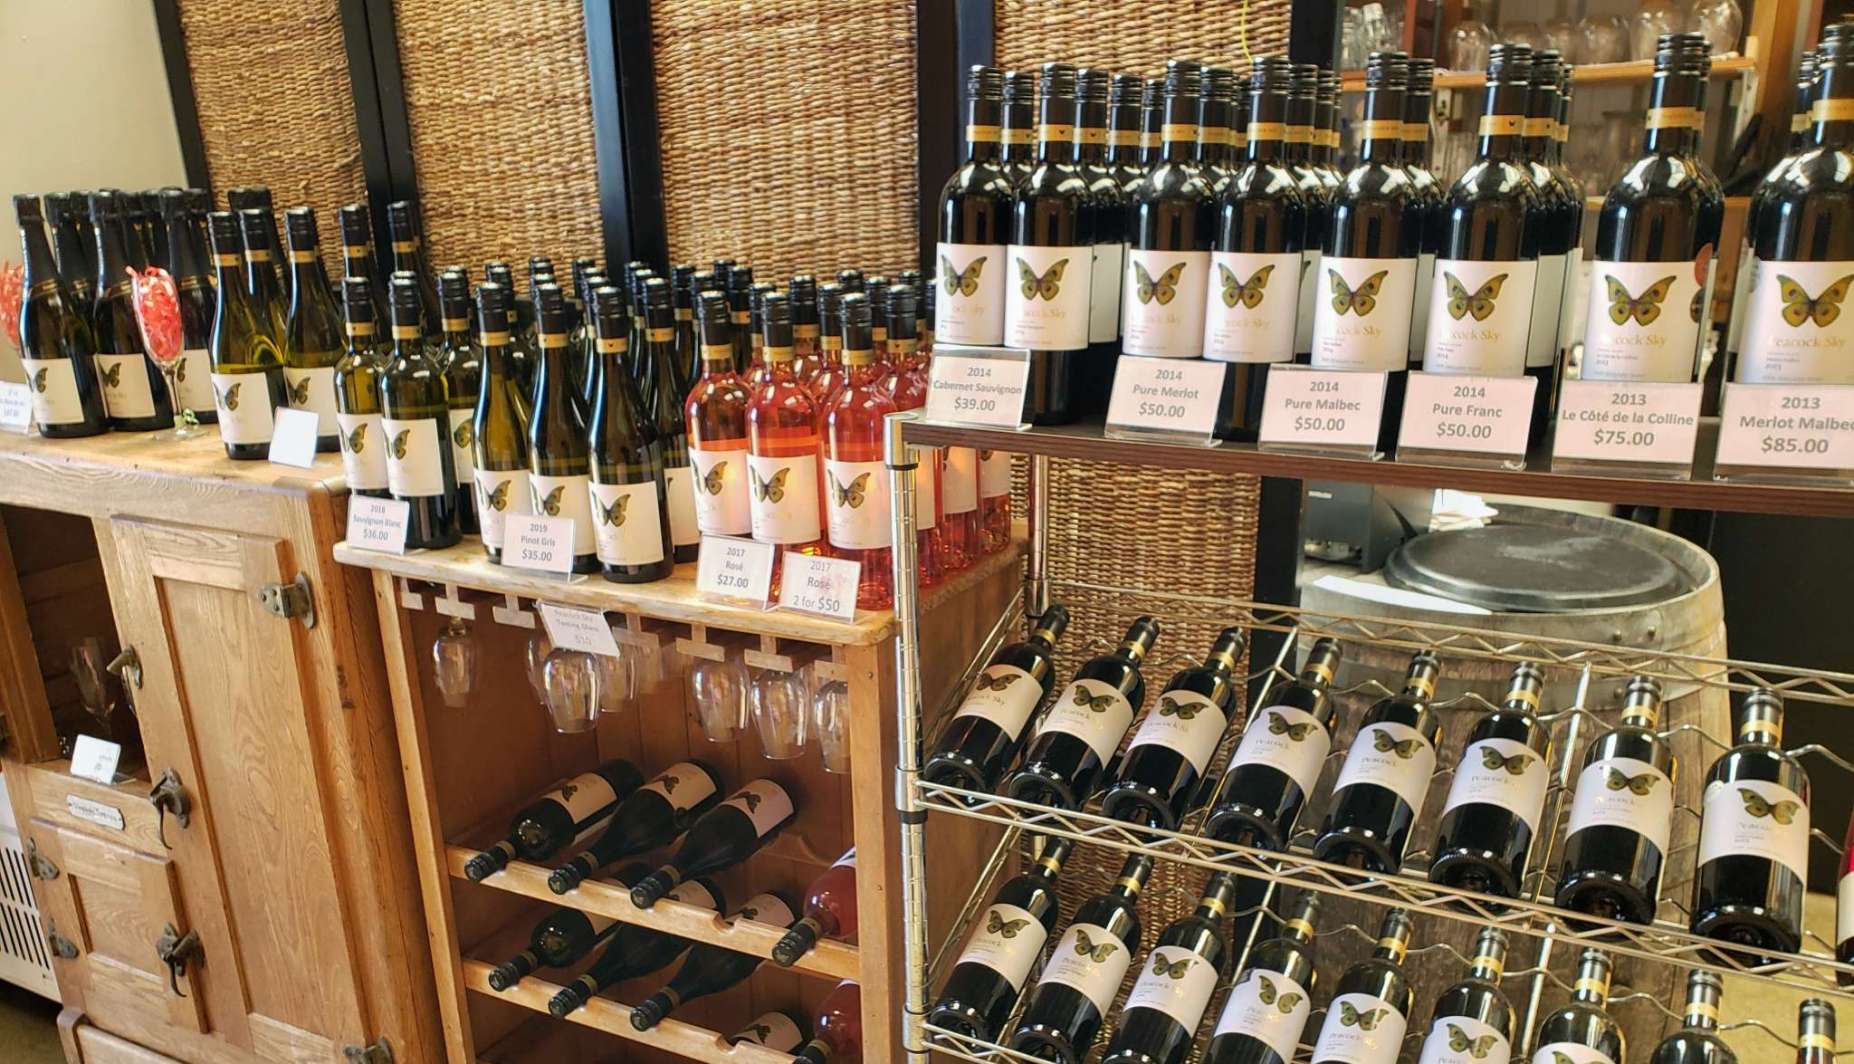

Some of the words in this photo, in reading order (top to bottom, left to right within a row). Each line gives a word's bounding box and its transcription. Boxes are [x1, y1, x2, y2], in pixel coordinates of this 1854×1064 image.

[967, 367, 992, 377] 2014
[1155, 369, 1183, 380] 2014
[934, 380, 973, 392] Cabernet
[975, 383, 1022, 395] Sauvignon
[1132, 384, 1159, 396] Pure
[1161, 387, 1199, 399] Merlot
[1309, 381, 1339, 392] 2014
[1453, 386, 1486, 398] 2014
[954, 397, 996, 411] $39.00
[1285, 398, 1312, 409] Pure
[1315, 398, 1361, 411] Malbec
[1611, 393, 1647, 406] 2013
[1781, 396, 1821, 410] 2013
[1138, 401, 1186, 418] $50.00
[1432, 403, 1463, 416] Pure
[1466, 405, 1503, 418] Franc
[1294, 416, 1345, 431] $50.00
[1562, 409, 1576, 421] Le
[1579, 410, 1609, 422] Côté
[1612, 411, 1629, 423] de
[1632, 411, 1644, 424] la
[1648, 412, 1694, 425] Colline
[1739, 415, 1794, 429] Merlot
[1436, 422, 1492, 439] $50.00
[1594, 427, 1655, 446] $75.00
[1761, 435, 1829, 454] $85.00
[521, 535, 540, 545] Pinot
[521, 548, 553, 561] $35.00
[810, 560, 831, 572] 2017
[717, 575, 749, 589] $27.00
[807, 576, 832, 590] Rosé
[793, 595, 800, 606] 2
[801, 596, 816, 609] for
[818, 596, 840, 612] $50
